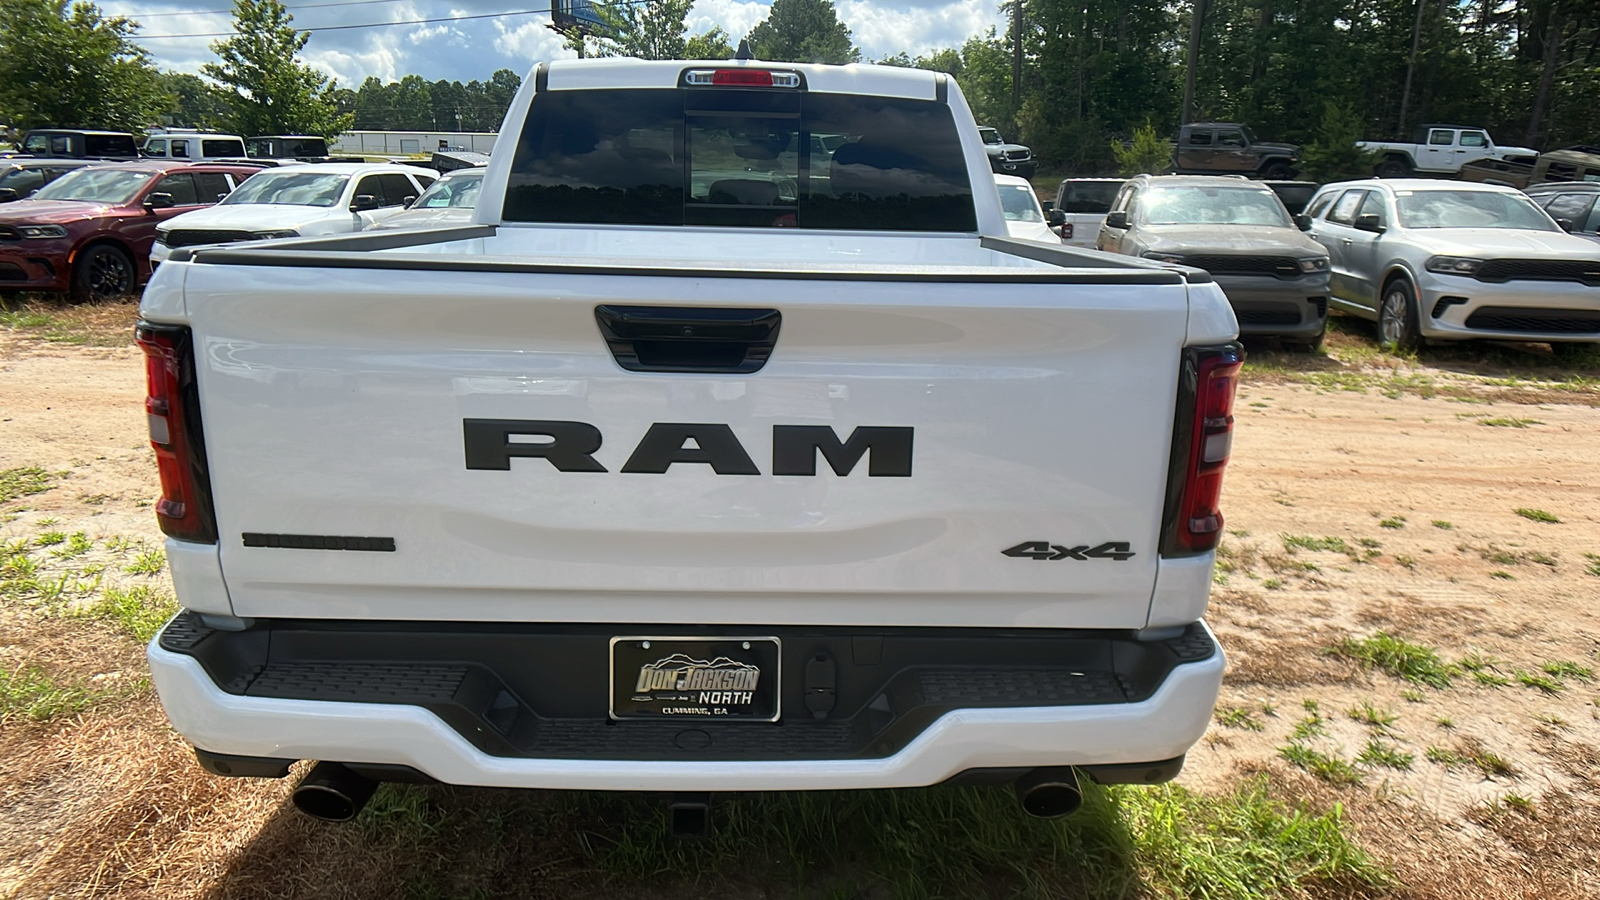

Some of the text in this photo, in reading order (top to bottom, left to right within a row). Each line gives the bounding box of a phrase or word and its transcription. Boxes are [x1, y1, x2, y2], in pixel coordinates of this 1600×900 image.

[463, 418, 914, 477] RAM
[1001, 541, 1136, 561] 4x4
[636, 667, 760, 692] DON JACKSON
[699, 691, 752, 704] NORTH
[662, 707, 728, 716] CUMMING, GA
